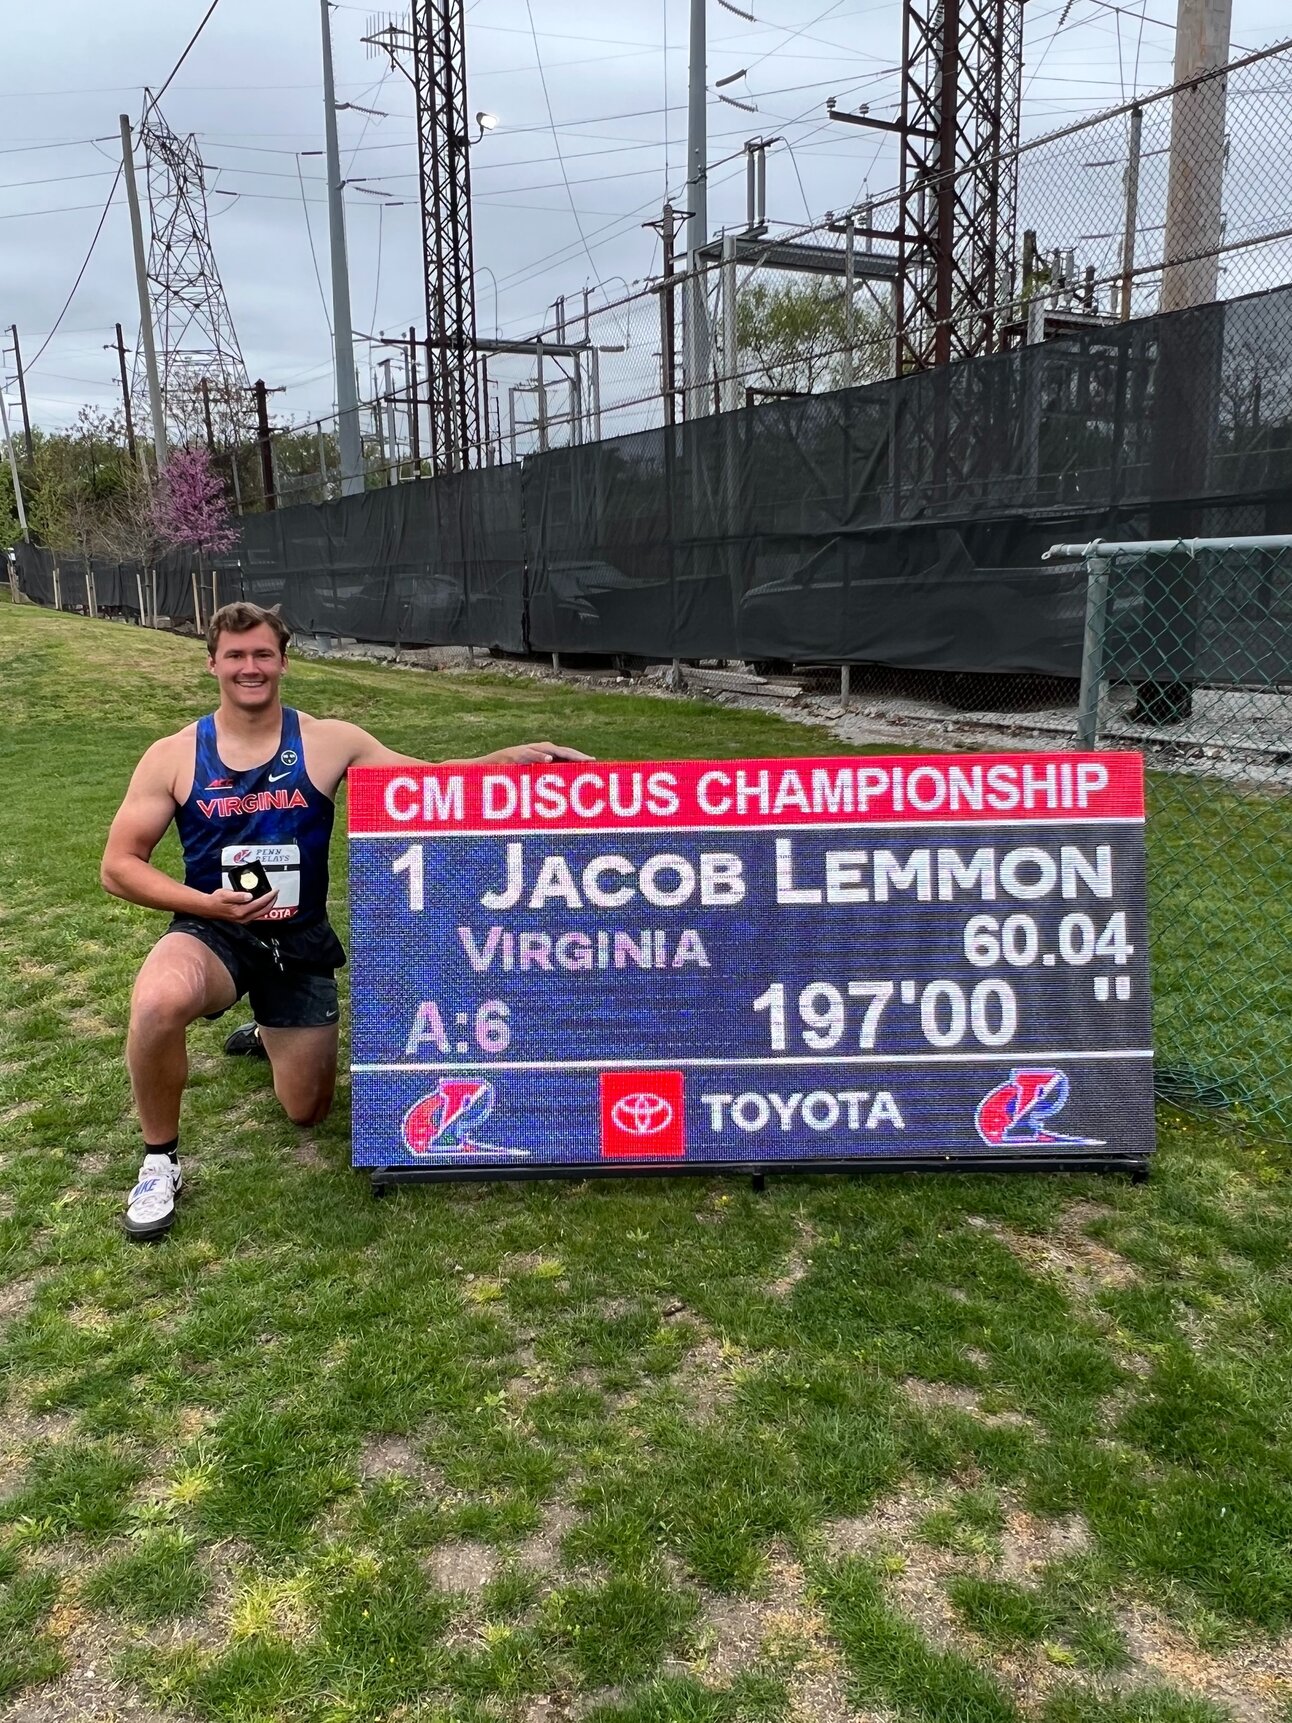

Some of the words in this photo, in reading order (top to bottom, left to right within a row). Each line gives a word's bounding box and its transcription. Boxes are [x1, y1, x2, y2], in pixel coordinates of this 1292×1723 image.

[196, 788, 308, 819] VIRGINIA
[384, 775, 465, 821] CM
[481, 772, 680, 819] DISCUS
[696, 763, 1109, 815] CHAMPIONSHIP
[391, 844, 425, 911] 1
[480, 842, 747, 910] JACOB
[775, 838, 1114, 905] LEMMON
[264, 909, 291, 919] OTA
[963, 911, 1134, 967] 60.04
[457, 926, 712, 972] VIRGINIA
[405, 1000, 512, 1055] A:6
[752, 978, 1019, 1051] 197'00
[700, 1090, 906, 1133] TOYOTA
